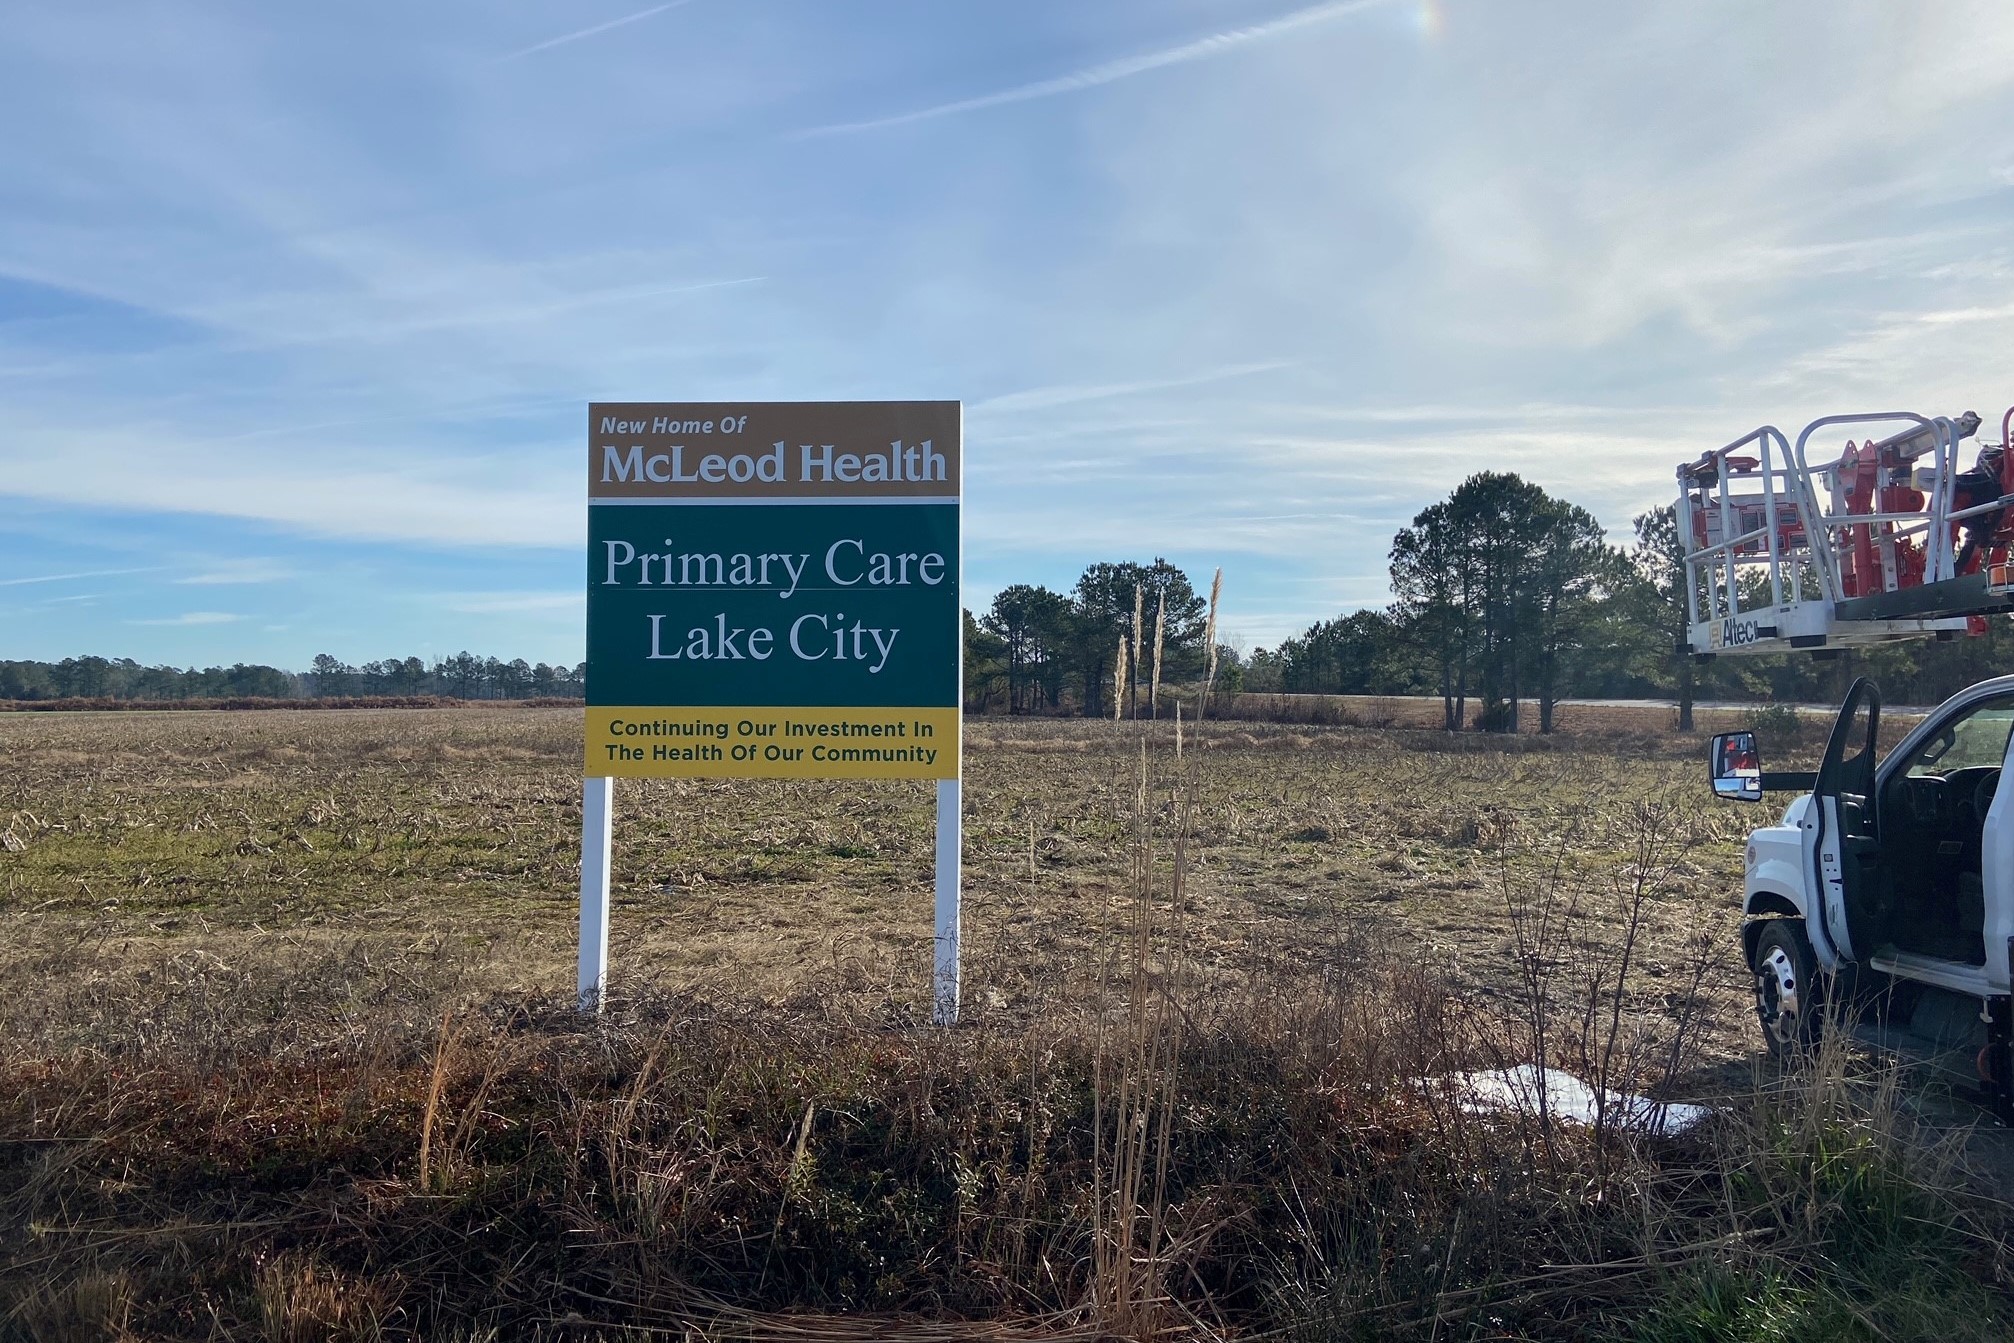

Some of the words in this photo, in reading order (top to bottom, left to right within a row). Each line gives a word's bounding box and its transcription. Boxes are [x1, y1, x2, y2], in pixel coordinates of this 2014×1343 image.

[601, 417, 646, 434] New
[652, 417, 713, 434] Home
[720, 416, 748, 434] Of
[600, 441, 787, 483] McLeod
[799, 440, 948, 482] Health
[602, 539, 810, 599] Primary
[825, 539, 945, 586] Care
[646, 613, 774, 660] Lake
[789, 613, 900, 674] City
[1723, 618, 1754, 647] Altec
[609, 720, 729, 738] Continuing
[737, 720, 776, 737] Our
[785, 720, 905, 737] Investment
[914, 722, 933, 737] In
[605, 744, 644, 761] The
[653, 744, 722, 761] Health
[731, 744, 757, 761] Of
[764, 745, 803, 762] Our
[812, 746, 938, 765] Community
